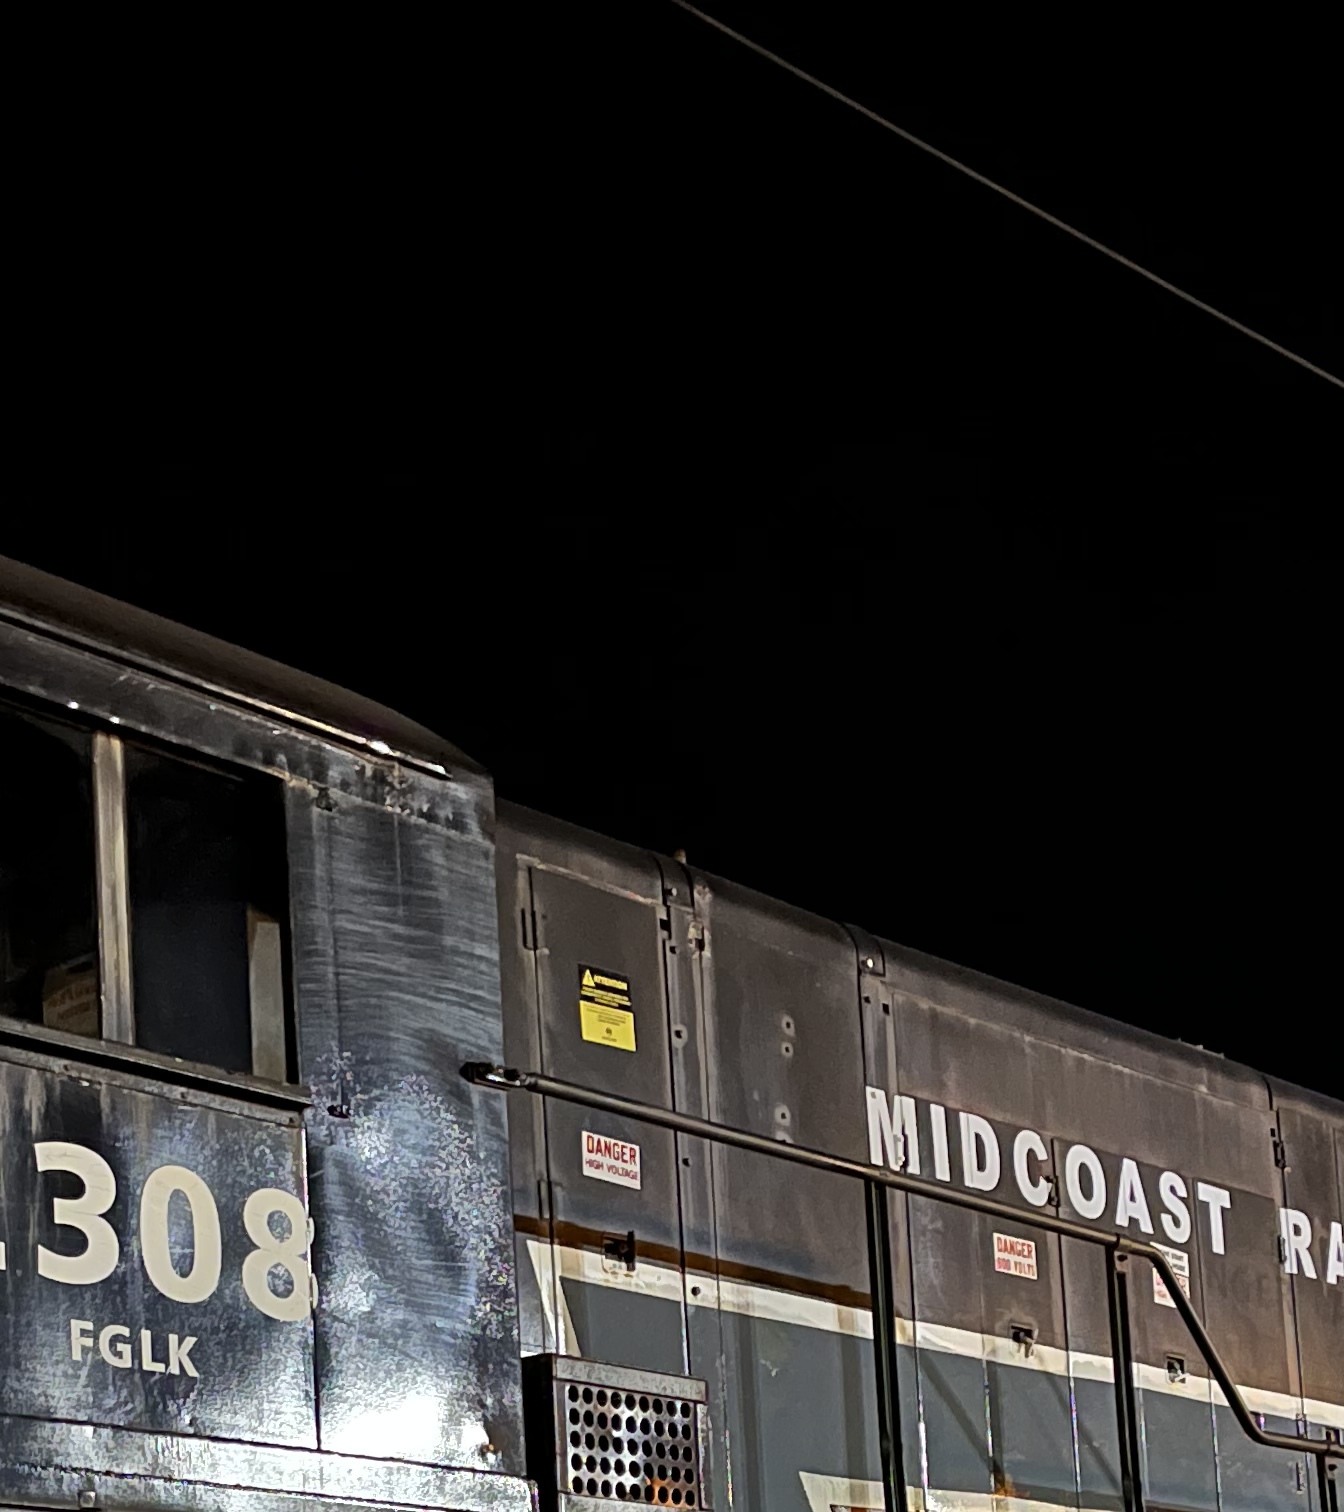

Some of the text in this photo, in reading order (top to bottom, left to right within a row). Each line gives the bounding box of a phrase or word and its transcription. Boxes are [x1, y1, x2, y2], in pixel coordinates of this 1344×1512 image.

[586, 1134, 637, 1165] DANGER
[585, 1158, 638, 1181] HIGH VOLTAGE
[865, 1085, 1232, 1256] MIDCOAST
[996, 1236, 1033, 1260] DANGER
[69, 1318, 199, 1378] FGLK
